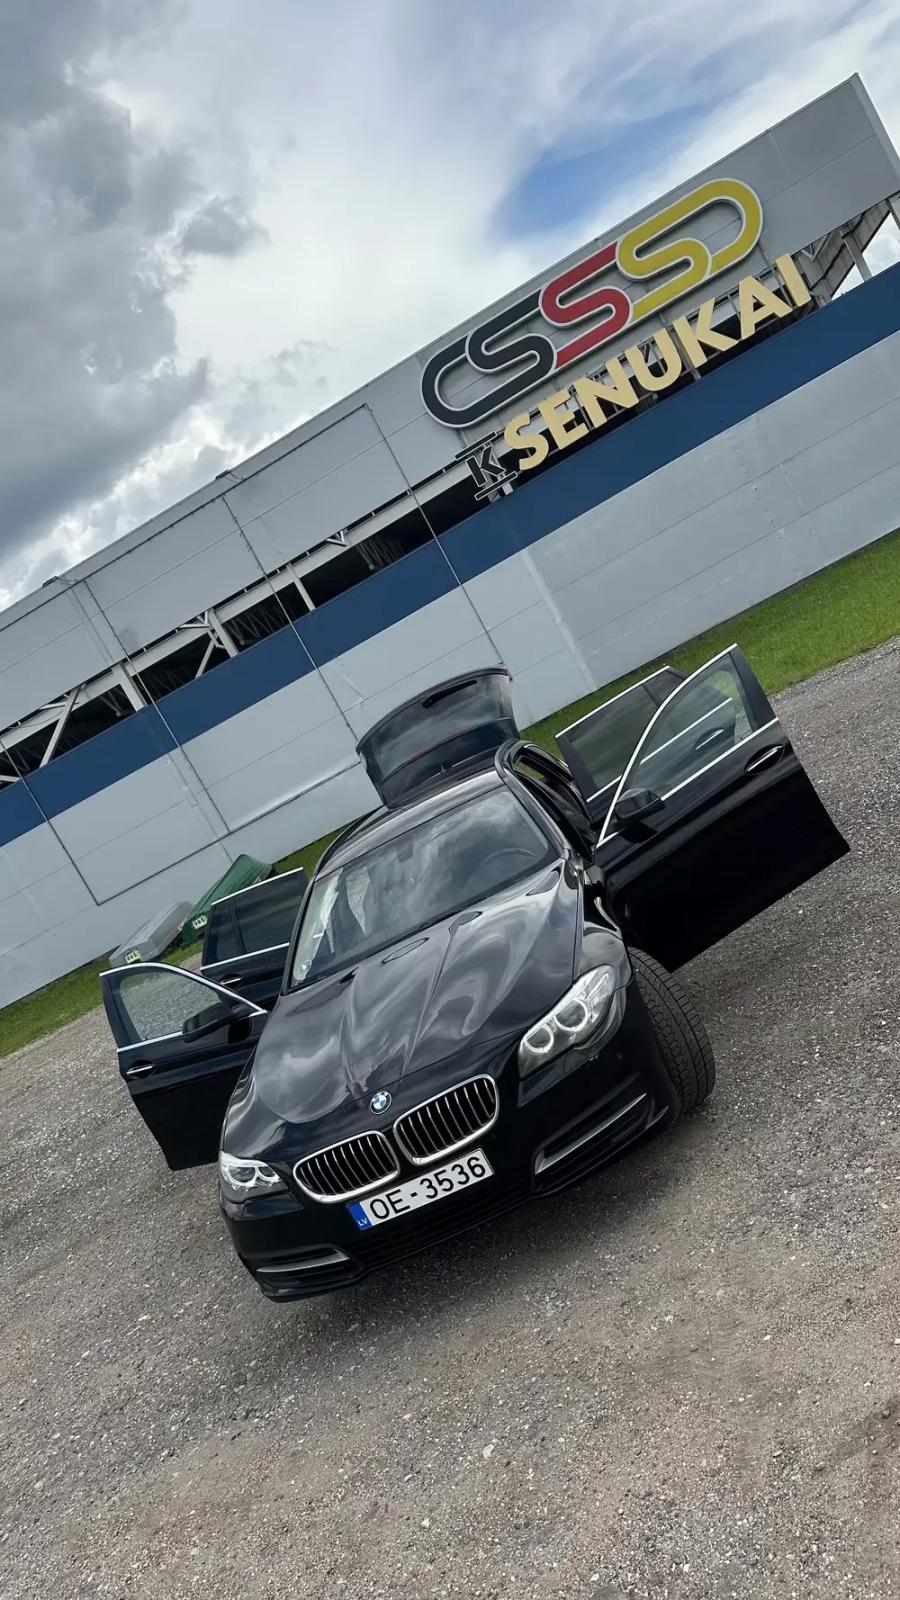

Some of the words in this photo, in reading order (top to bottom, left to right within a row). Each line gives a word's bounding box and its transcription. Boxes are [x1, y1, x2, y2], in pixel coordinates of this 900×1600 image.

[504, 253, 812, 471] SENUKAI
[357, 1217, 368, 1227] LV
[369, 1156, 486, 1220] OE-3536
